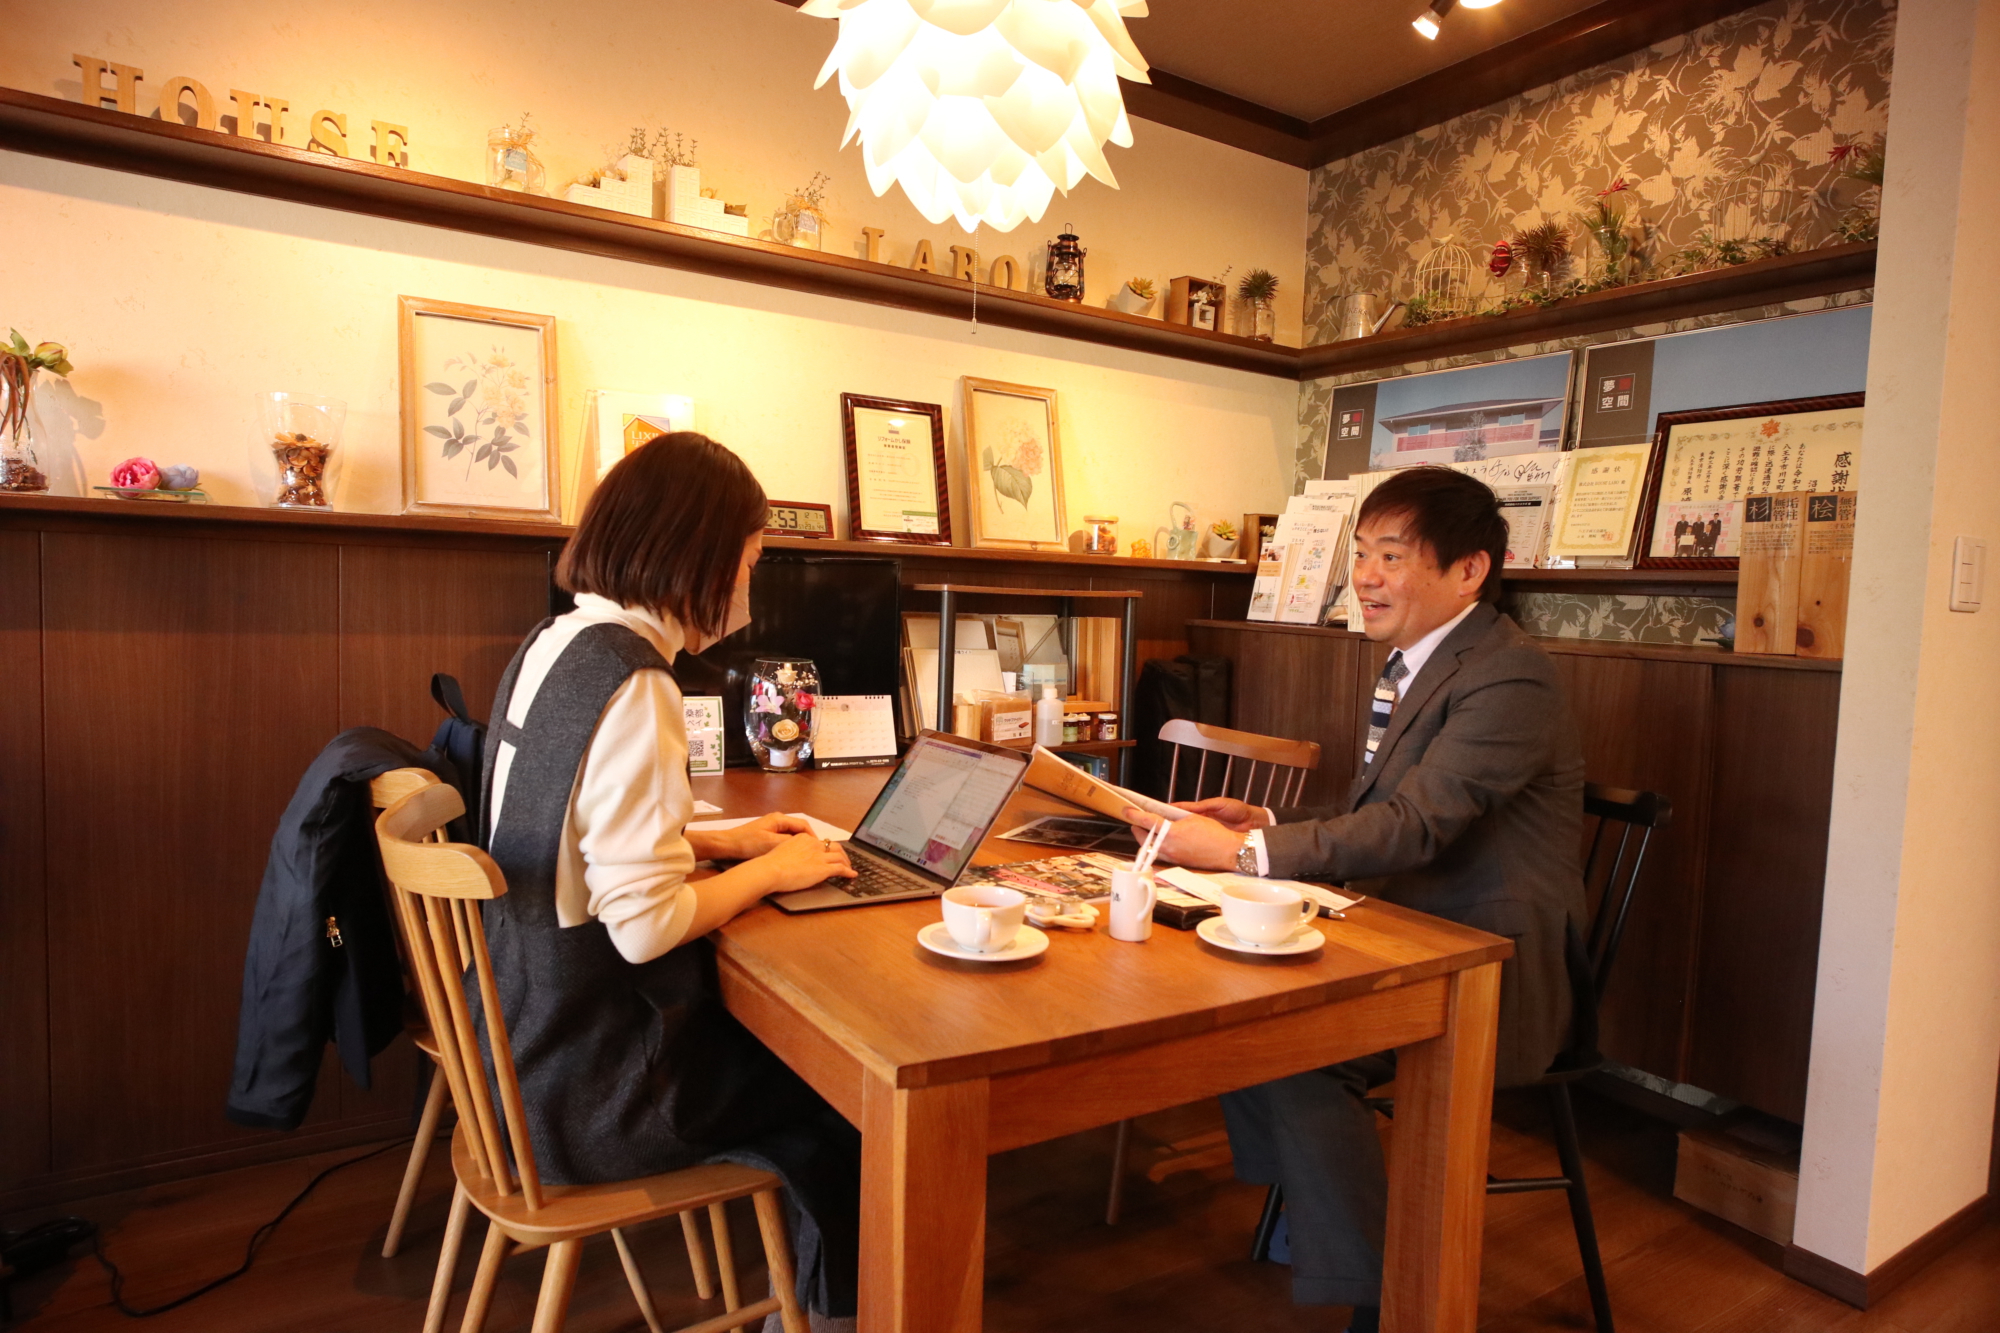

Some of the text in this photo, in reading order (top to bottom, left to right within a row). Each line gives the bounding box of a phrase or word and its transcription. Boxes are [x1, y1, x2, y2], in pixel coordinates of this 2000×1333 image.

[73, 53, 408, 168] HOUSE
[862, 226, 1027, 292] LABO
[1601, 395, 1630, 408] 空間
